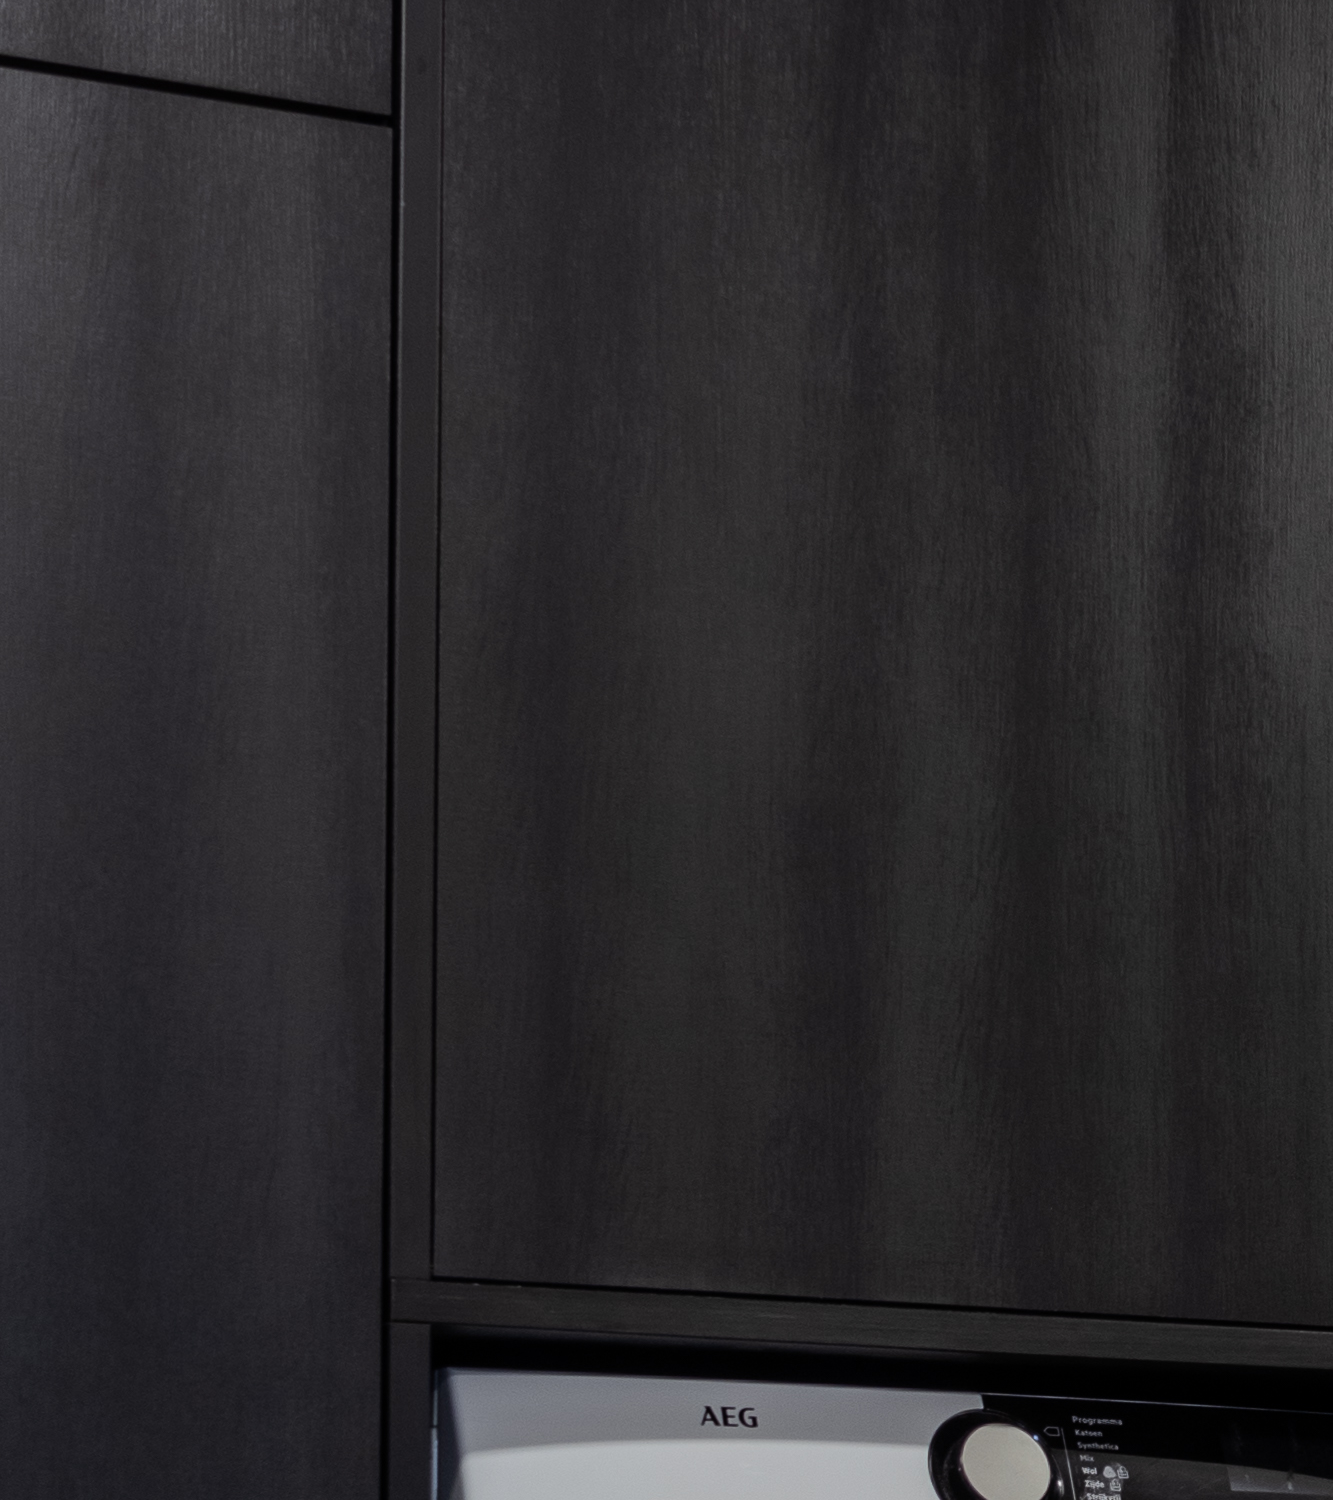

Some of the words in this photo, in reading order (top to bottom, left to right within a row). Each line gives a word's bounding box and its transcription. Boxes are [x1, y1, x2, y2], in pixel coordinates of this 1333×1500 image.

[700, 1405, 758, 1428] AEG
[1072, 1415, 1123, 1426] Programma
[1074, 1429, 1103, 1437] Katoen
[1077, 1442, 1119, 1451] Synthetica
[1081, 1467, 1098, 1475] Wol
